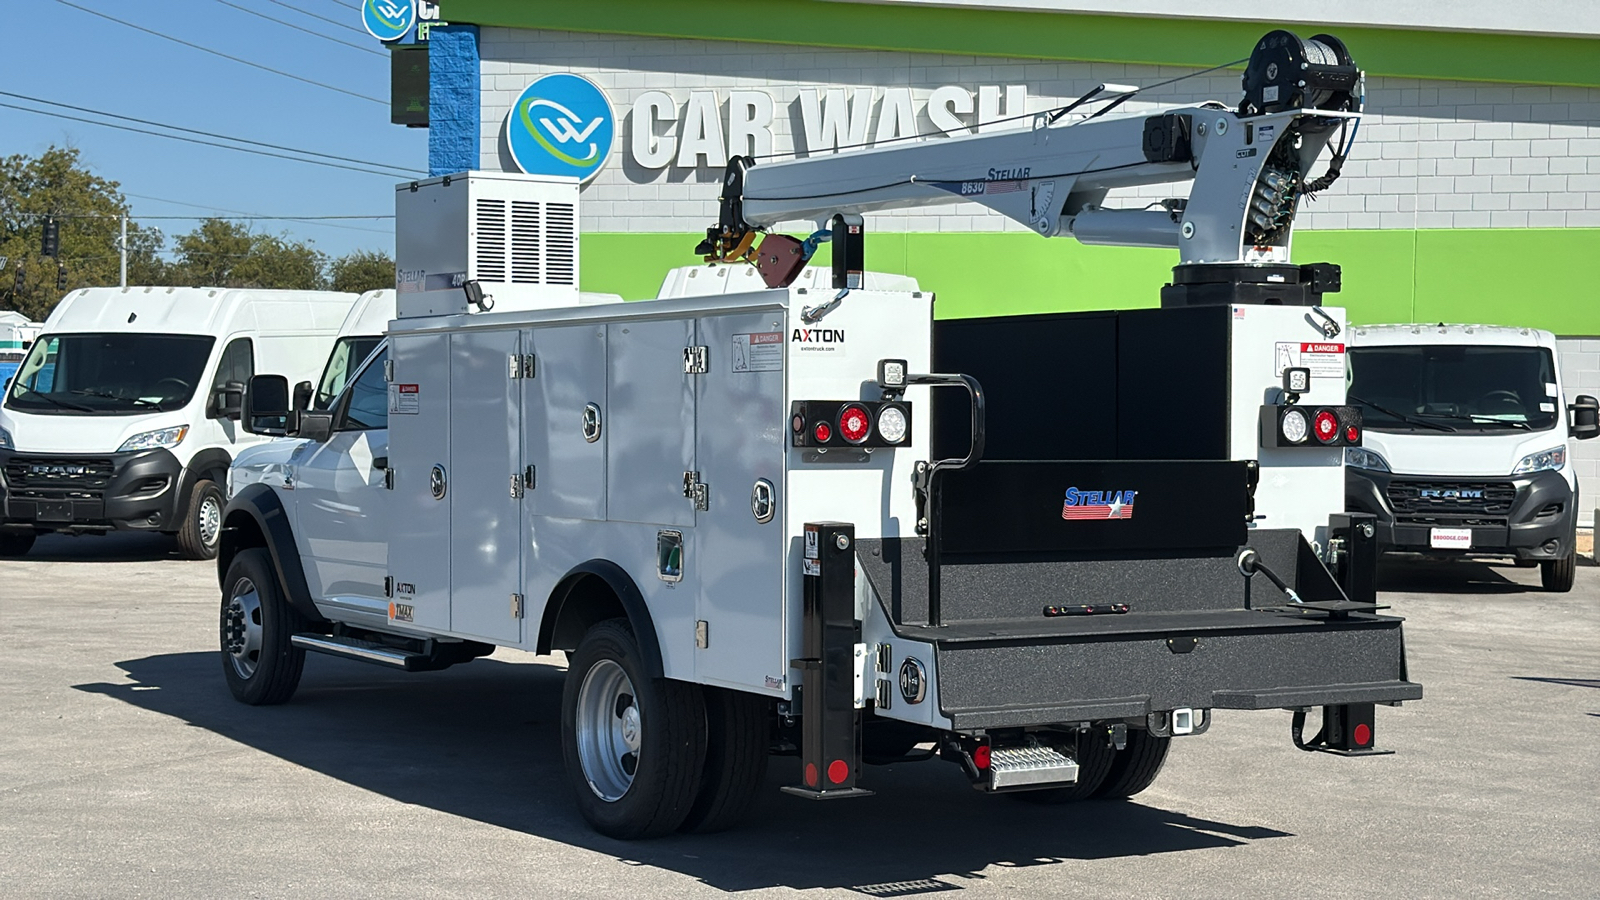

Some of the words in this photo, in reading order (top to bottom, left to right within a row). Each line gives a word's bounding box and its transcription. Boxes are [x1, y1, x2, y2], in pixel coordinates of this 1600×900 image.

[631, 89, 775, 168] CAR
[799, 85, 1027, 157] WASH
[987, 167, 1031, 181] STELLAR
[961, 181, 983, 194] 8630
[760, 334, 779, 342] DANGER
[792, 328, 845, 343] AXTON
[32, 466, 84, 474] RAM
[1065, 487, 1135, 507] STELLAR
[1421, 489, 1483, 498] RAM
[396, 582, 416, 595] AXTON
